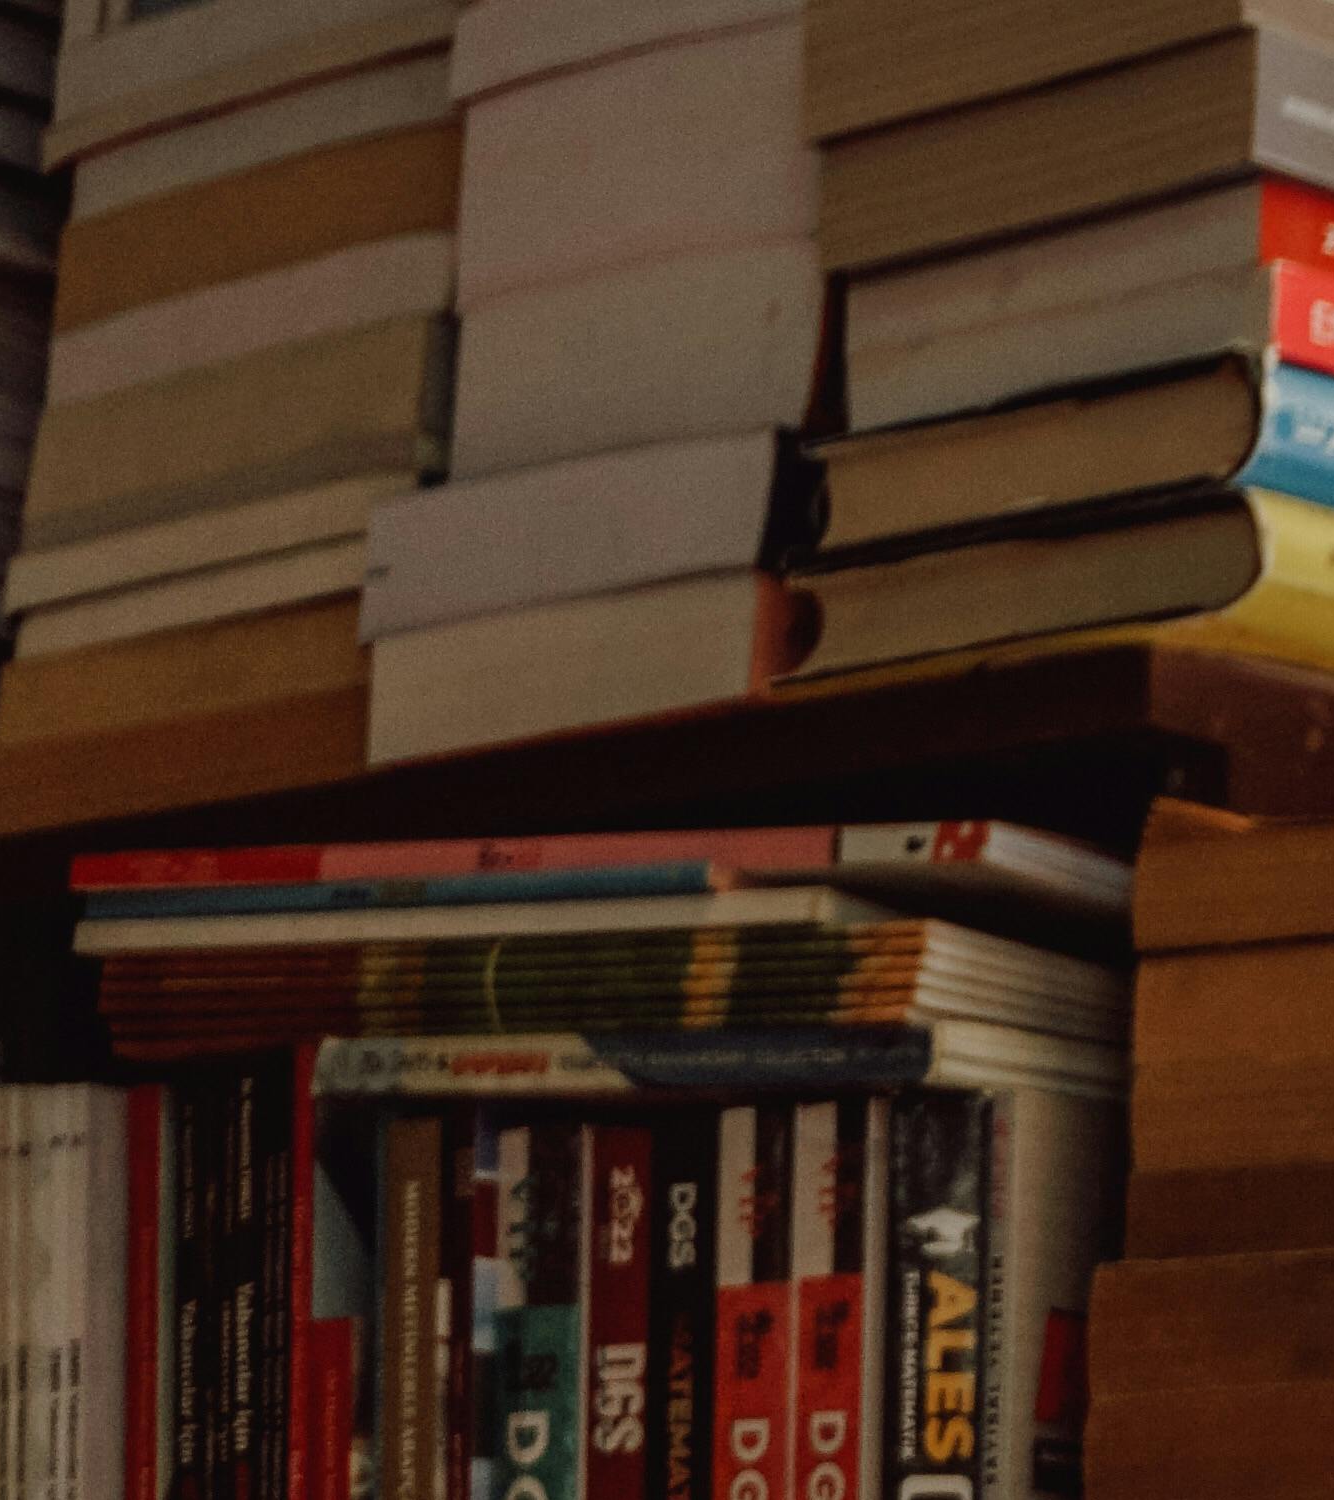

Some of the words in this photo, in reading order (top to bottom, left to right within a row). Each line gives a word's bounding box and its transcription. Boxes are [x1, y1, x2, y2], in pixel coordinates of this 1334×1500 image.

[401, 1180, 420, 1278] MODERN
[668, 1181, 698, 1271] DGS
[179, 1299, 199, 1419] Yabancılar
[235, 1280, 255, 1405] Yabancılar
[593, 1343, 648, 1455] DGS
[922, 1270, 978, 1465] ALES
